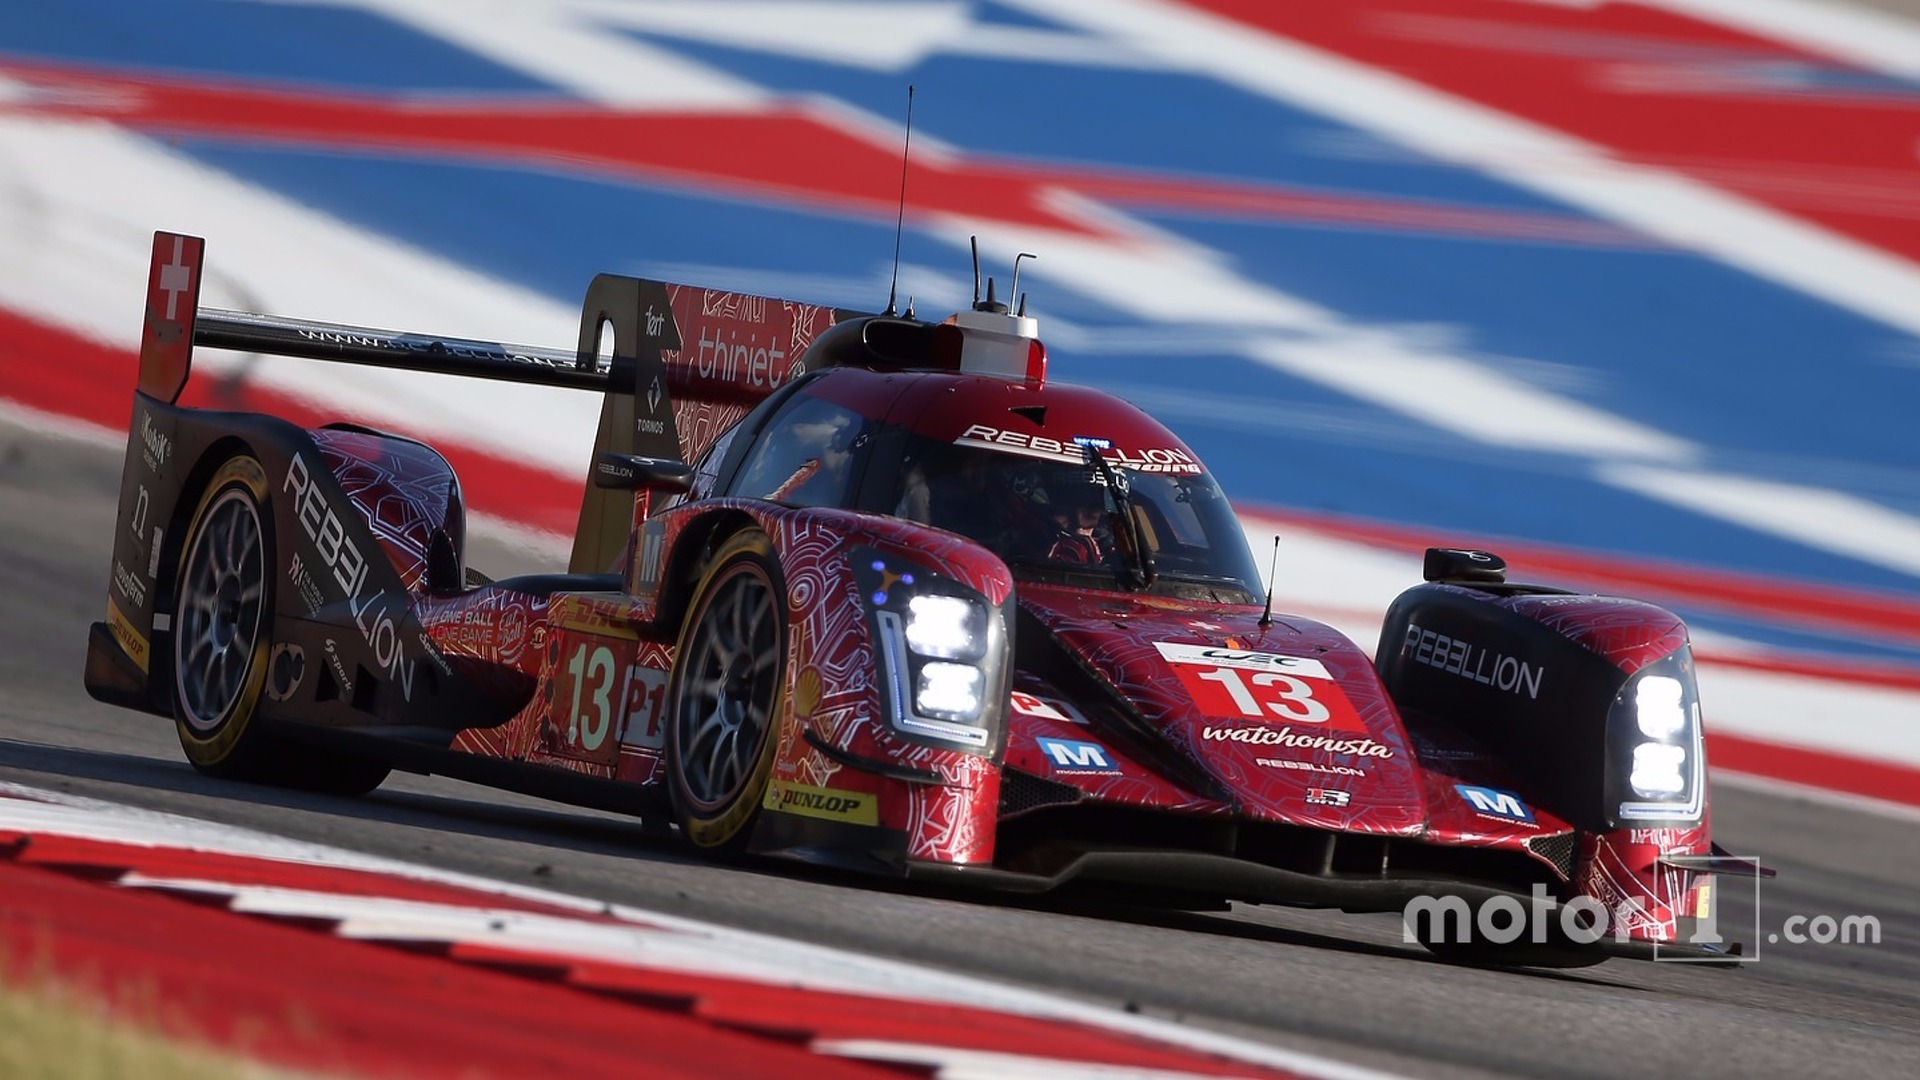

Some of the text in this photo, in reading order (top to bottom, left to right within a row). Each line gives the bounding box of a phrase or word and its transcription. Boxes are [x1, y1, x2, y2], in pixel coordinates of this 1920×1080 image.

[699, 326, 785, 389] thiriet
[637, 418, 664, 435] TORNOS
[598, 462, 634, 478] REBELLION
[283, 451, 415, 702] REBELLION
[464, 610, 494, 627] BALL
[460, 626, 493, 644] GAME
[1201, 649, 1299, 667] WEC
[1402, 624, 1544, 699] REBELLION
[568, 642, 616, 751] 13
[624, 674, 668, 738] P1
[1197, 667, 1332, 723] 13
[1047, 743, 1109, 767] M
[1203, 726, 1395, 759] watchonista
[1255, 757, 1367, 778] REBELLION
[780, 788, 862, 813] DUNLOP
[1465, 789, 1526, 818] M
